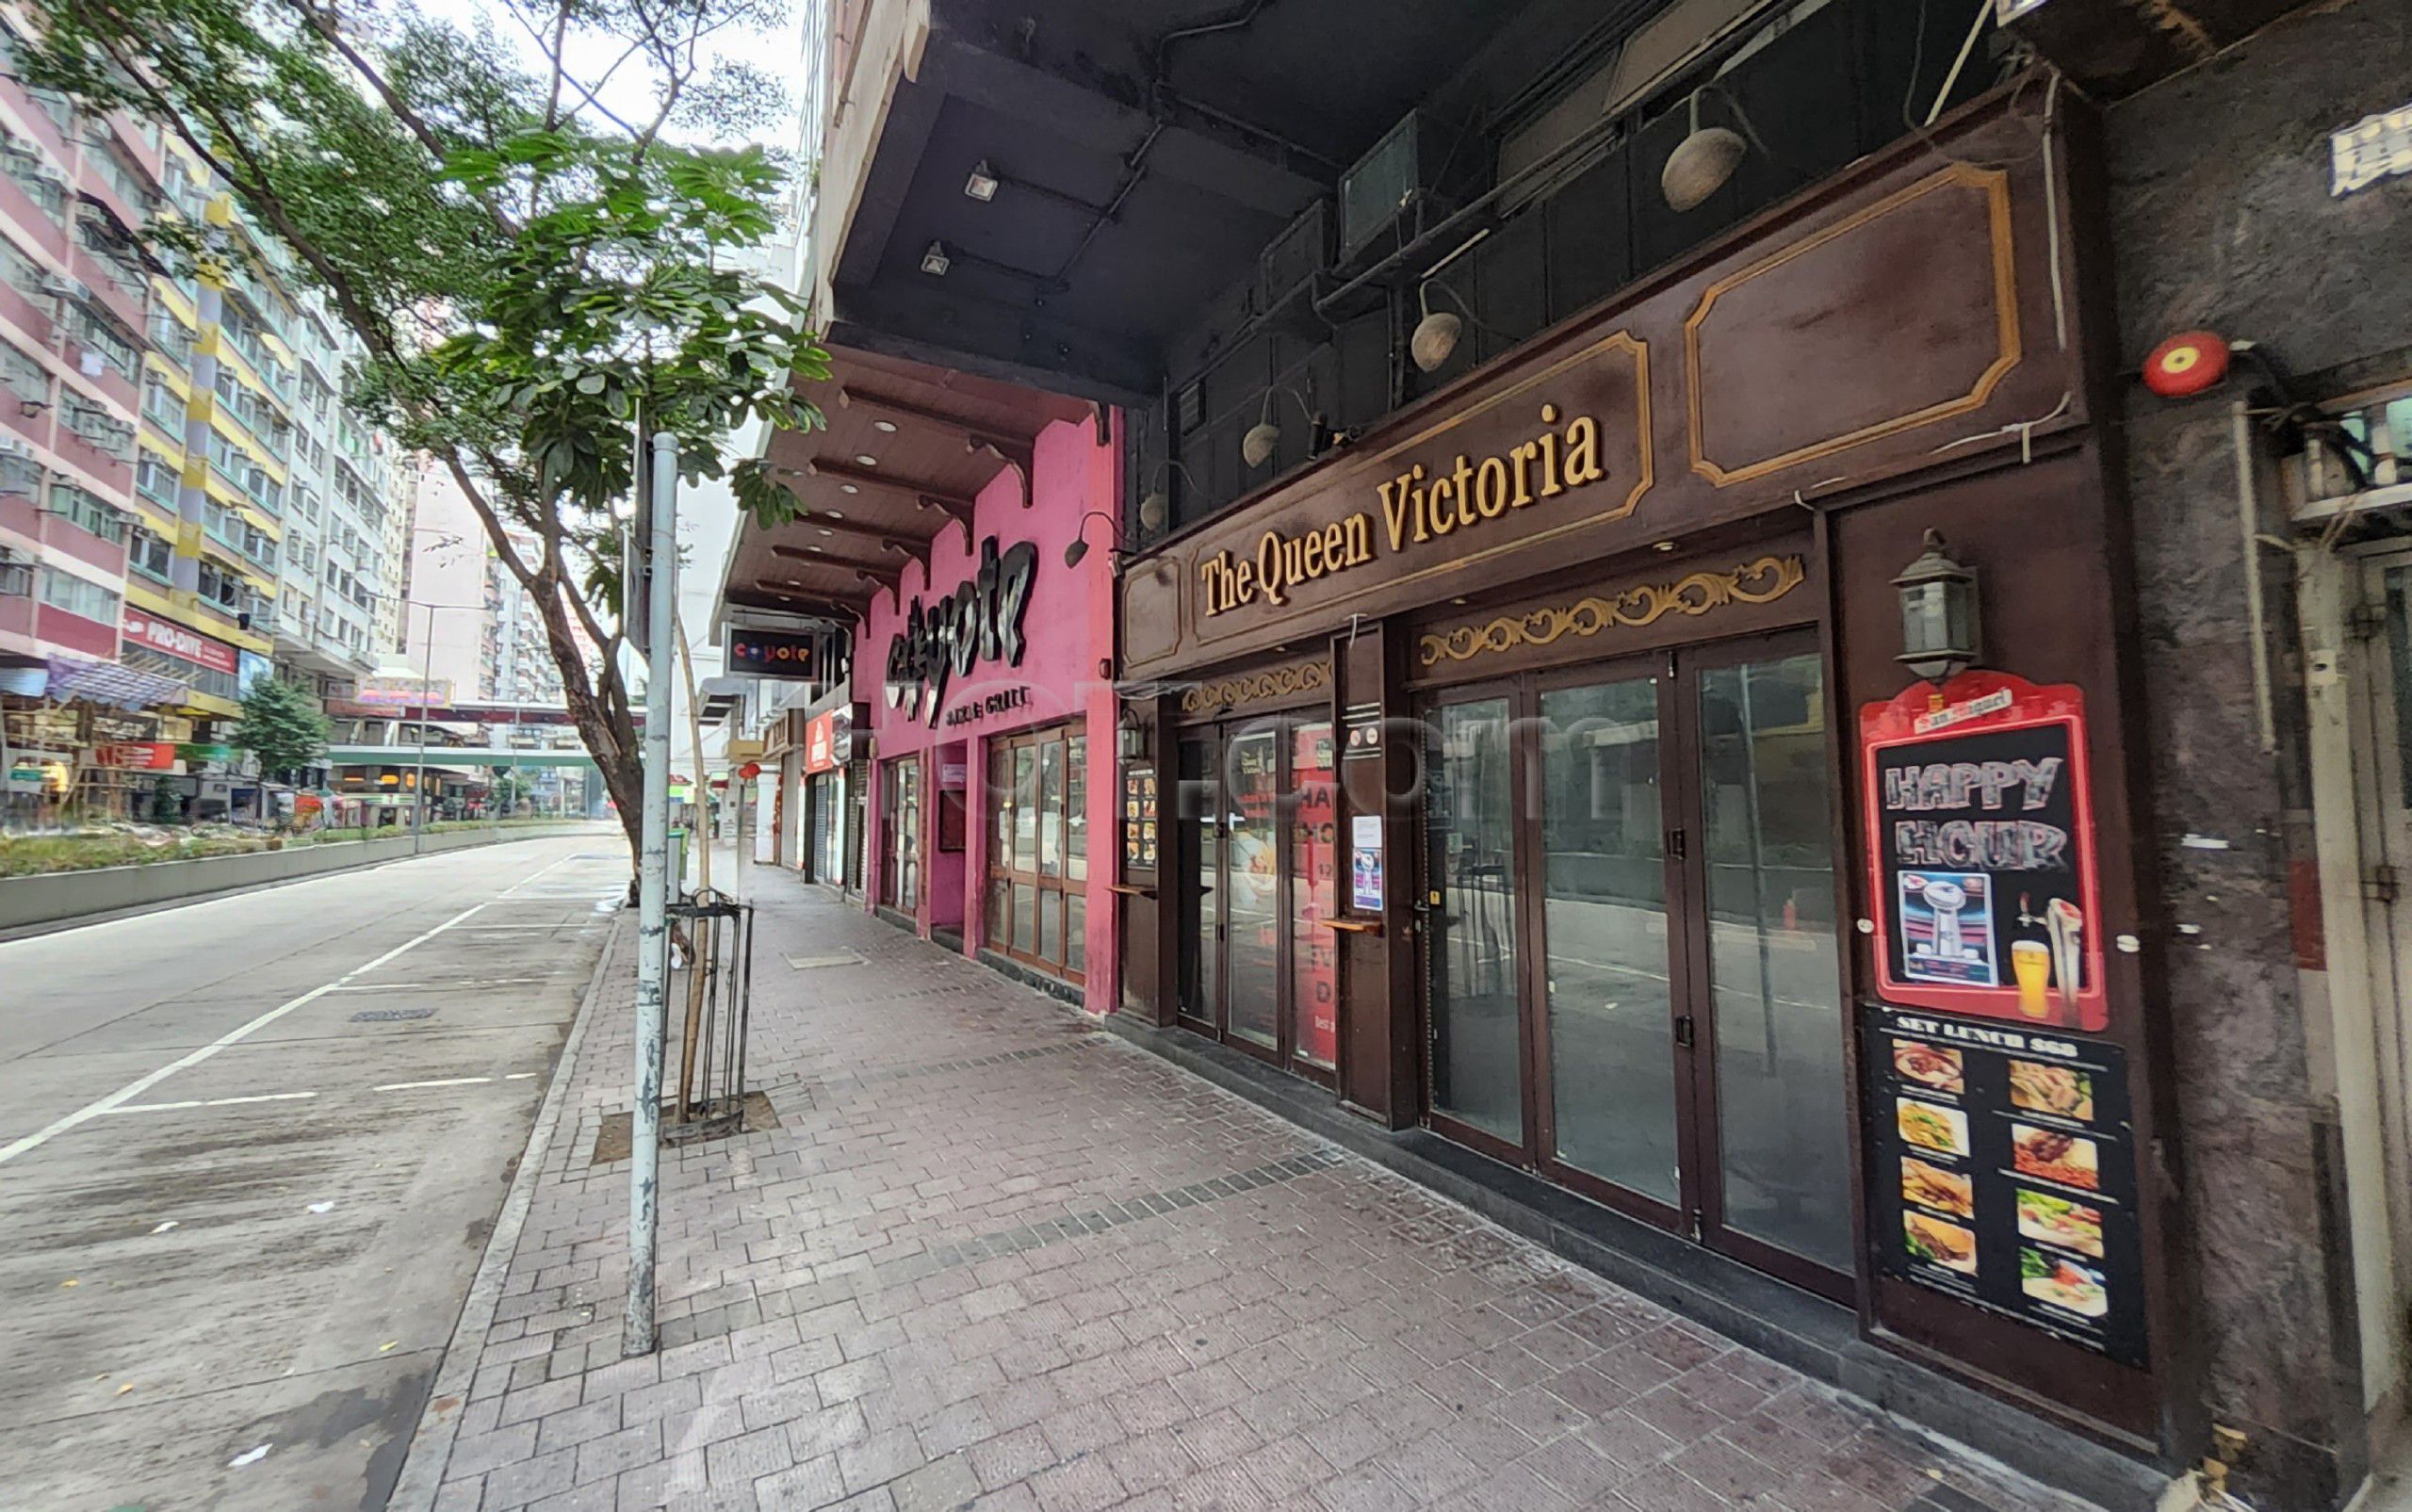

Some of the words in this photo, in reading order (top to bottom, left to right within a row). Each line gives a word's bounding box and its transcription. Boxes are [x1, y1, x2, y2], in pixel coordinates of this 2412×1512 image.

[1201, 550, 1254, 617] The
[1257, 512, 1373, 605] Queen
[1377, 403, 1604, 552] Victoria
[733, 642, 810, 663] coyote
[1884, 756, 2064, 811] HAPPY
[1895, 820, 2069, 873] HOUR
[1897, 1016, 1939, 1034] SET
[1943, 1024, 2025, 1049] LUNCH
